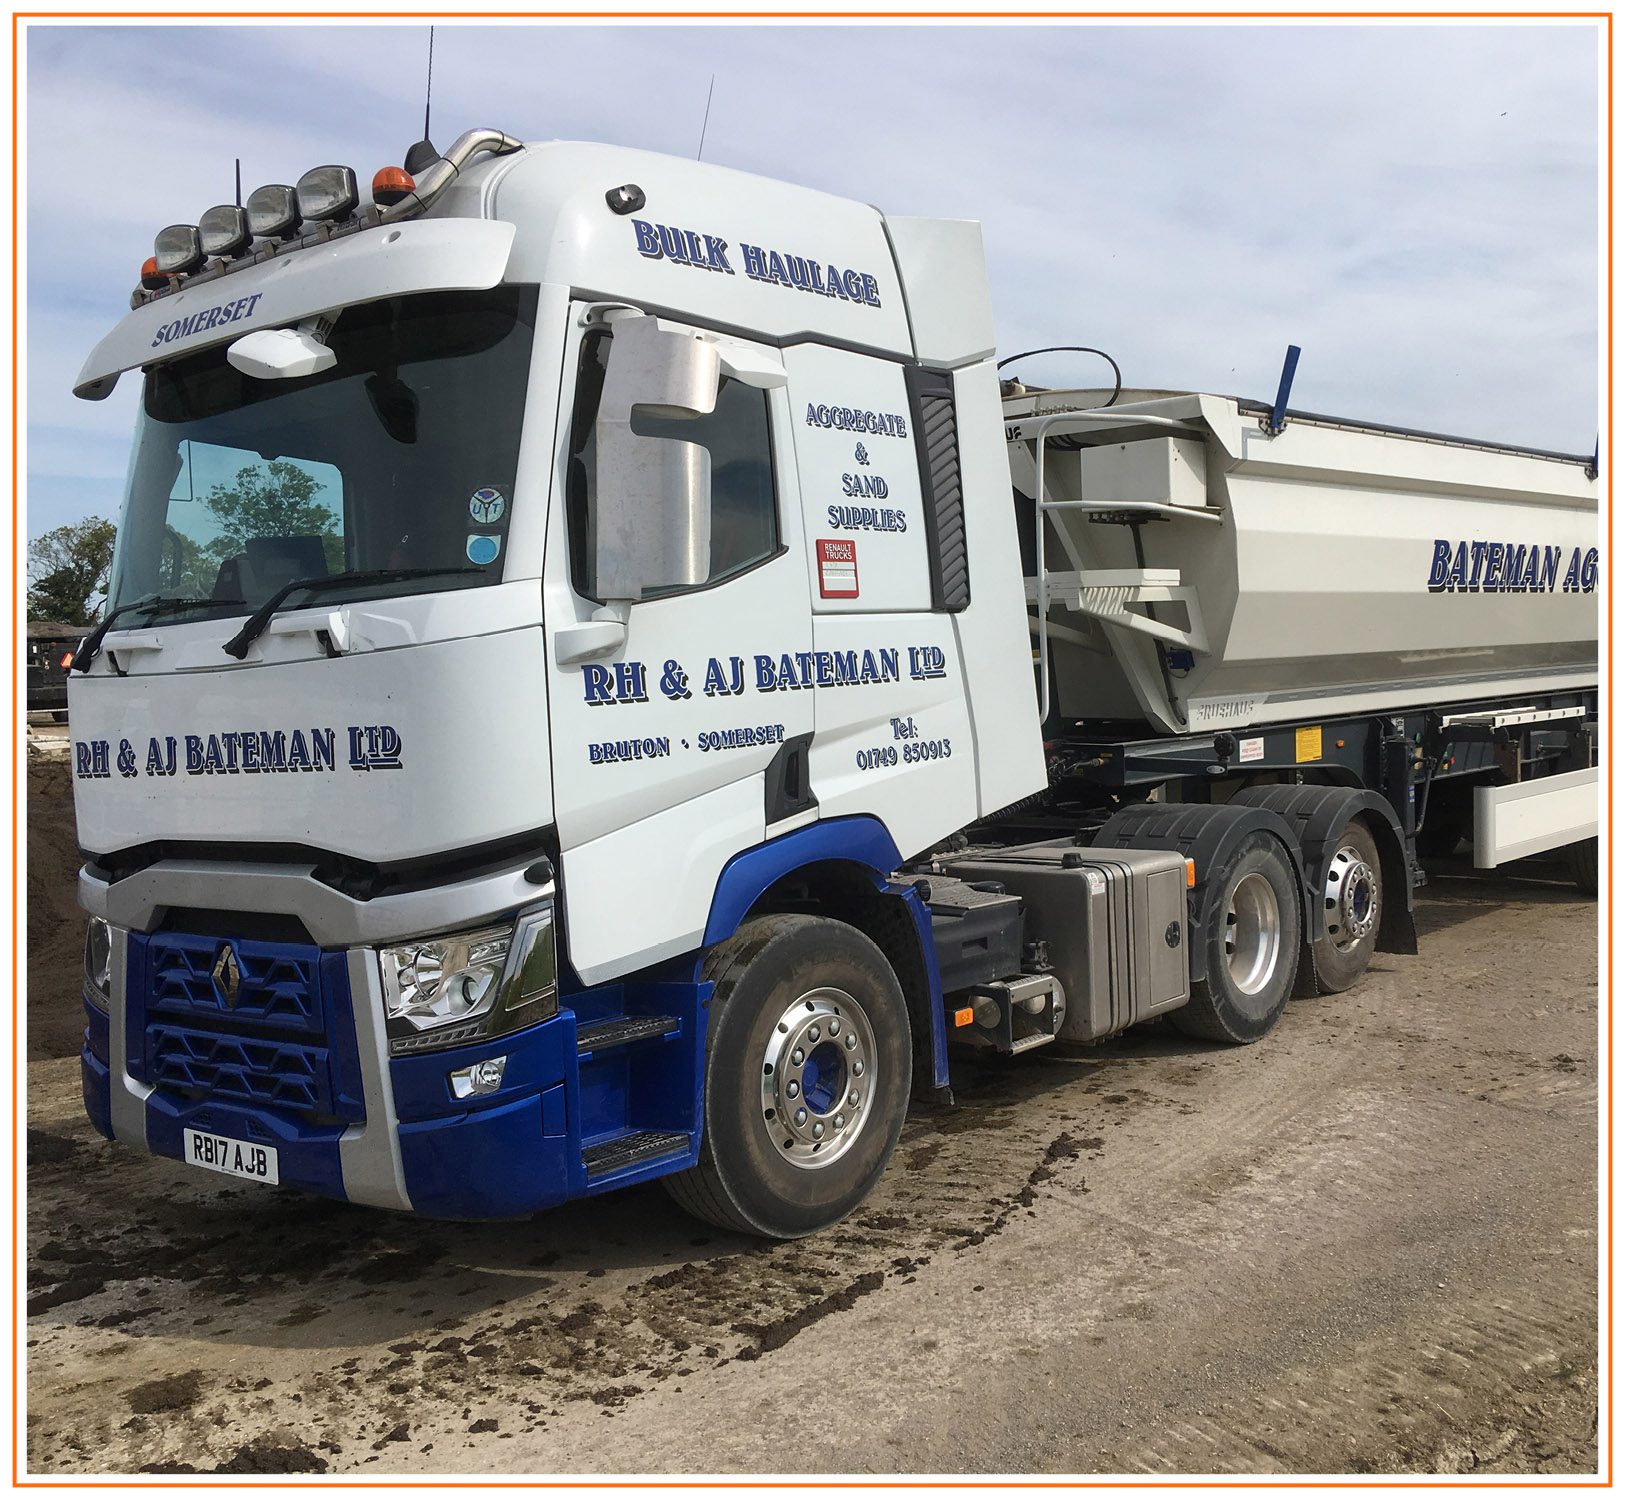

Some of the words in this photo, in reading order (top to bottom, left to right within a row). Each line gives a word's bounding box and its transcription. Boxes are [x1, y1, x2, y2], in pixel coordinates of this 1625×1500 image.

[631, 219, 735, 275] BULK
[740, 243, 882, 308] HAULAGE
[152, 293, 262, 347] SOMERSET
[806, 403, 907, 438] AGGREGATE
[855, 442, 870, 465] &
[842, 473, 888, 499] SAND
[828, 505, 907, 532] SUPPLIES
[825, 544, 851, 552] RENAULT
[826, 552, 852, 560] TRUCKS
[1427, 539, 1561, 593] BATEMAN
[581, 661, 649, 706] RH
[660, 659, 692, 700] &
[703, 656, 744, 697] AJ
[754, 647, 899, 693] BATEMAN
[588, 736, 670, 764] BRUTON
[698, 723, 784, 751] SOMERSET
[891, 717, 918, 740] Tel:
[76, 741, 110, 779] RH
[117, 738, 138, 778] &
[146, 736, 177, 777] AJ
[185, 728, 335, 776] BATEMAN
[856, 746, 898, 770] 01749
[903, 738, 952, 763] 850913
[193, 1134, 228, 1167] RB17
[234, 1144, 267, 1177] AJB
